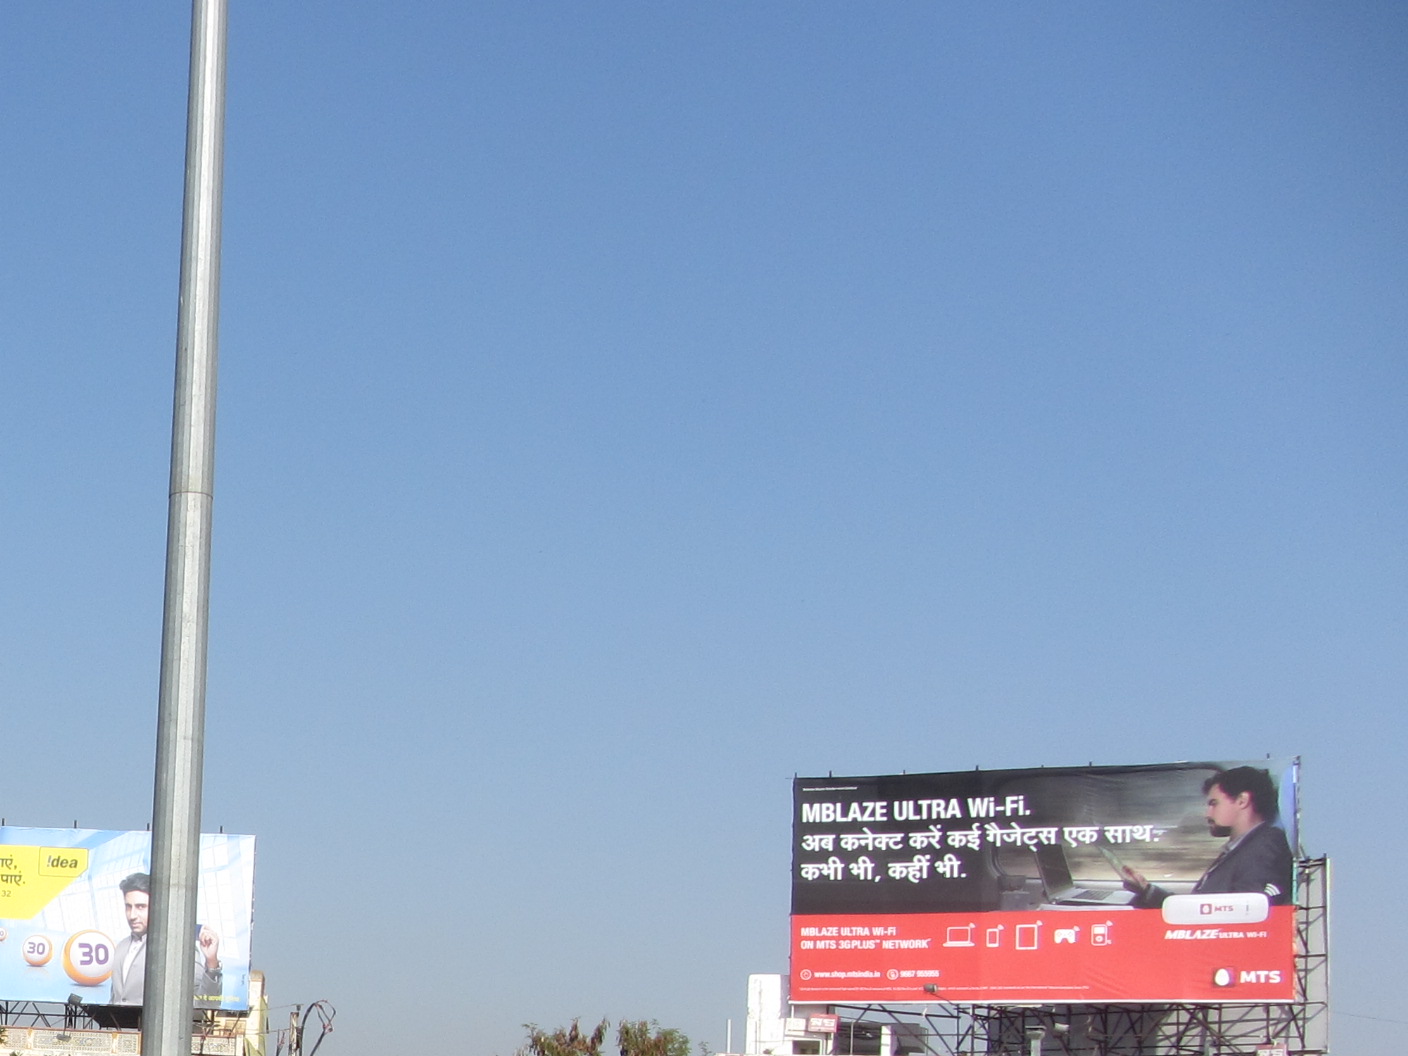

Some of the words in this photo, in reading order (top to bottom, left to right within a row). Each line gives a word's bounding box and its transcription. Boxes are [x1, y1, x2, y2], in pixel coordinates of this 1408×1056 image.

[802, 801, 887, 823] MBLAZE
[894, 799, 962, 821] ULTRA
[968, 795, 1031, 818] Wi-Fi.
[801, 833, 836, 851] अब
[840, 827, 904, 851] कनेक्ट
[908, 825, 942, 849] करें
[947, 823, 981, 850] कई
[984, 822, 1058, 852] गैजेट्स
[1063, 827, 1099, 848] एक
[801, 856, 845, 881] कभी
[849, 856, 881, 883] भी,
[888, 855, 930, 883] कहीं
[934, 853, 967, 878] भी.
[800, 927, 838, 936] MBLAZE
[841, 927, 869, 936] ULTRA
[872, 926, 896, 936] Wi-Fi
[1164, 929, 1221, 939] MBLAZE
[27, 942, 45, 955] 30
[800, 940, 814, 949] ON
[816, 940, 836, 949] MTS
[78, 942, 109, 966] 30
[1240, 970, 1281, 983] MTS
